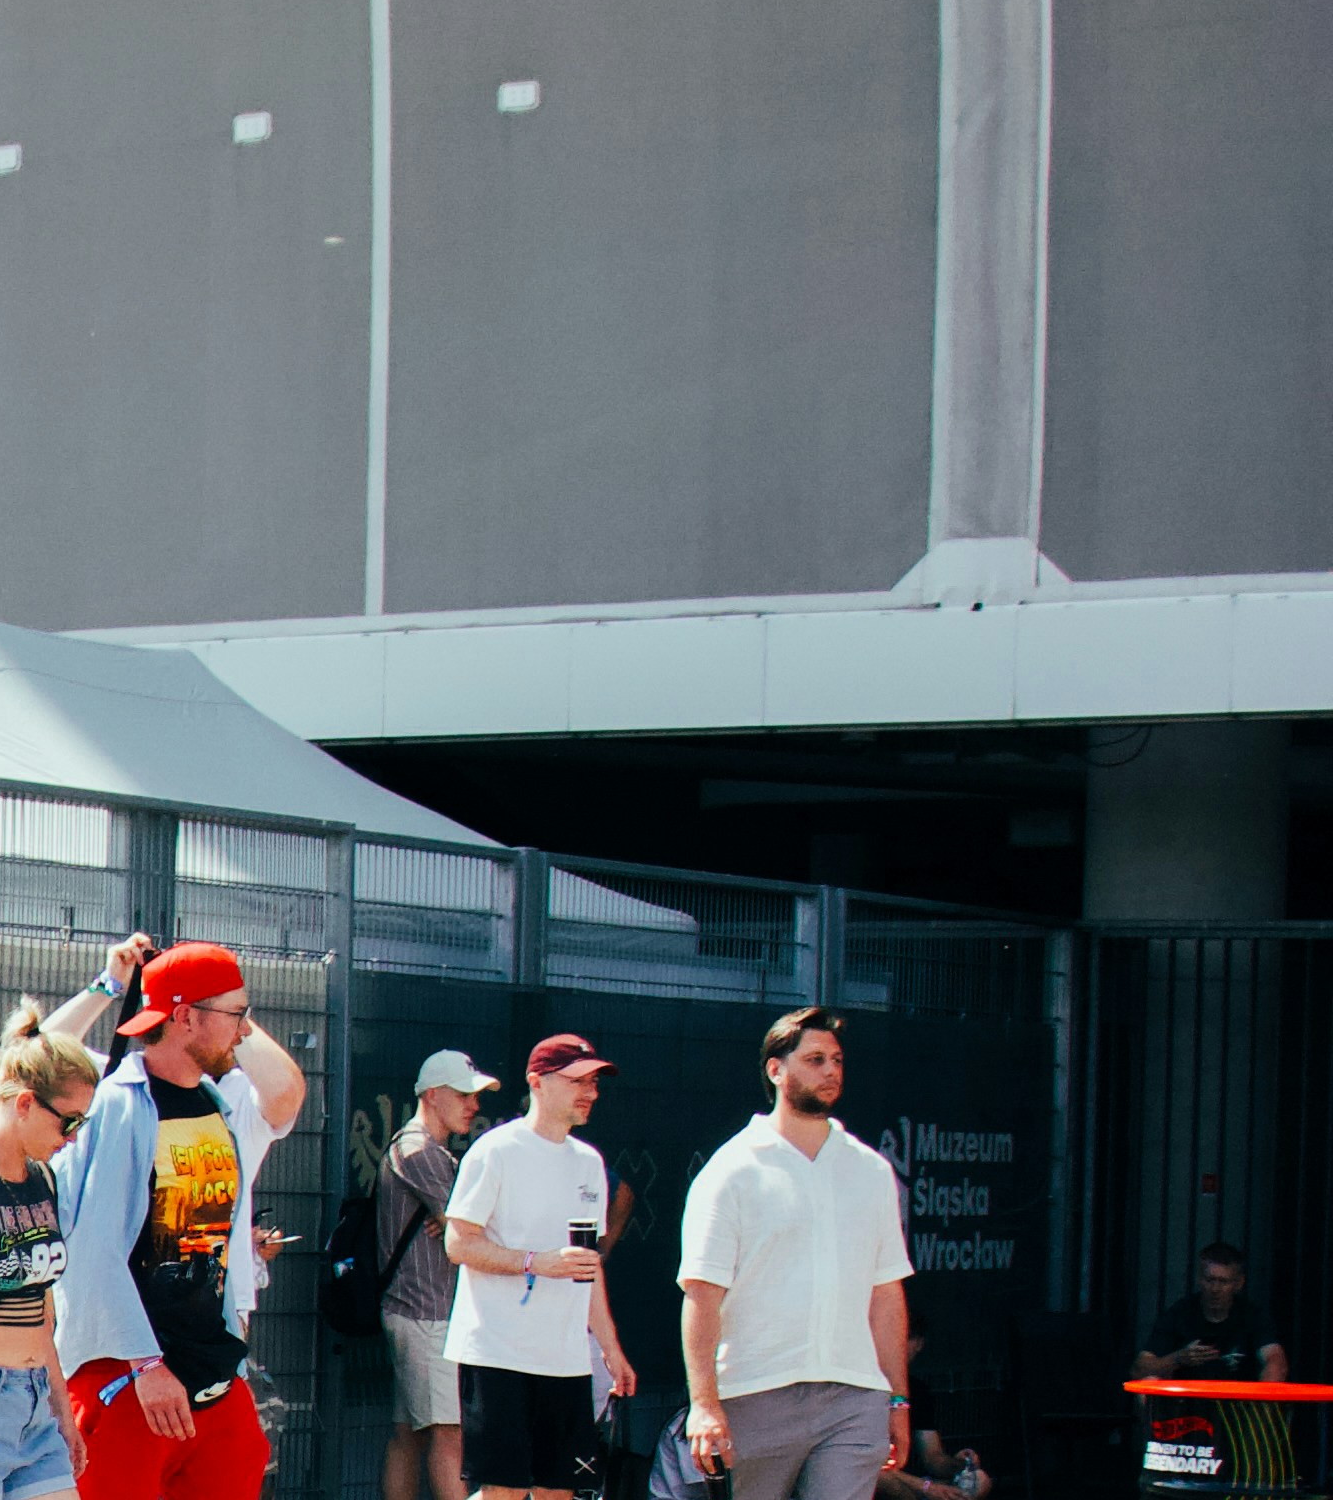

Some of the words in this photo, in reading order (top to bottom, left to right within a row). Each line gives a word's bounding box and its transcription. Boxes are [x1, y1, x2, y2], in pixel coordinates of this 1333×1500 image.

[915, 1123, 1015, 1163] Muzeum
[913, 1166, 989, 1228] Śląska
[23, 1241, 68, 1285] 92
[914, 1231, 1015, 1270] Wrocław
